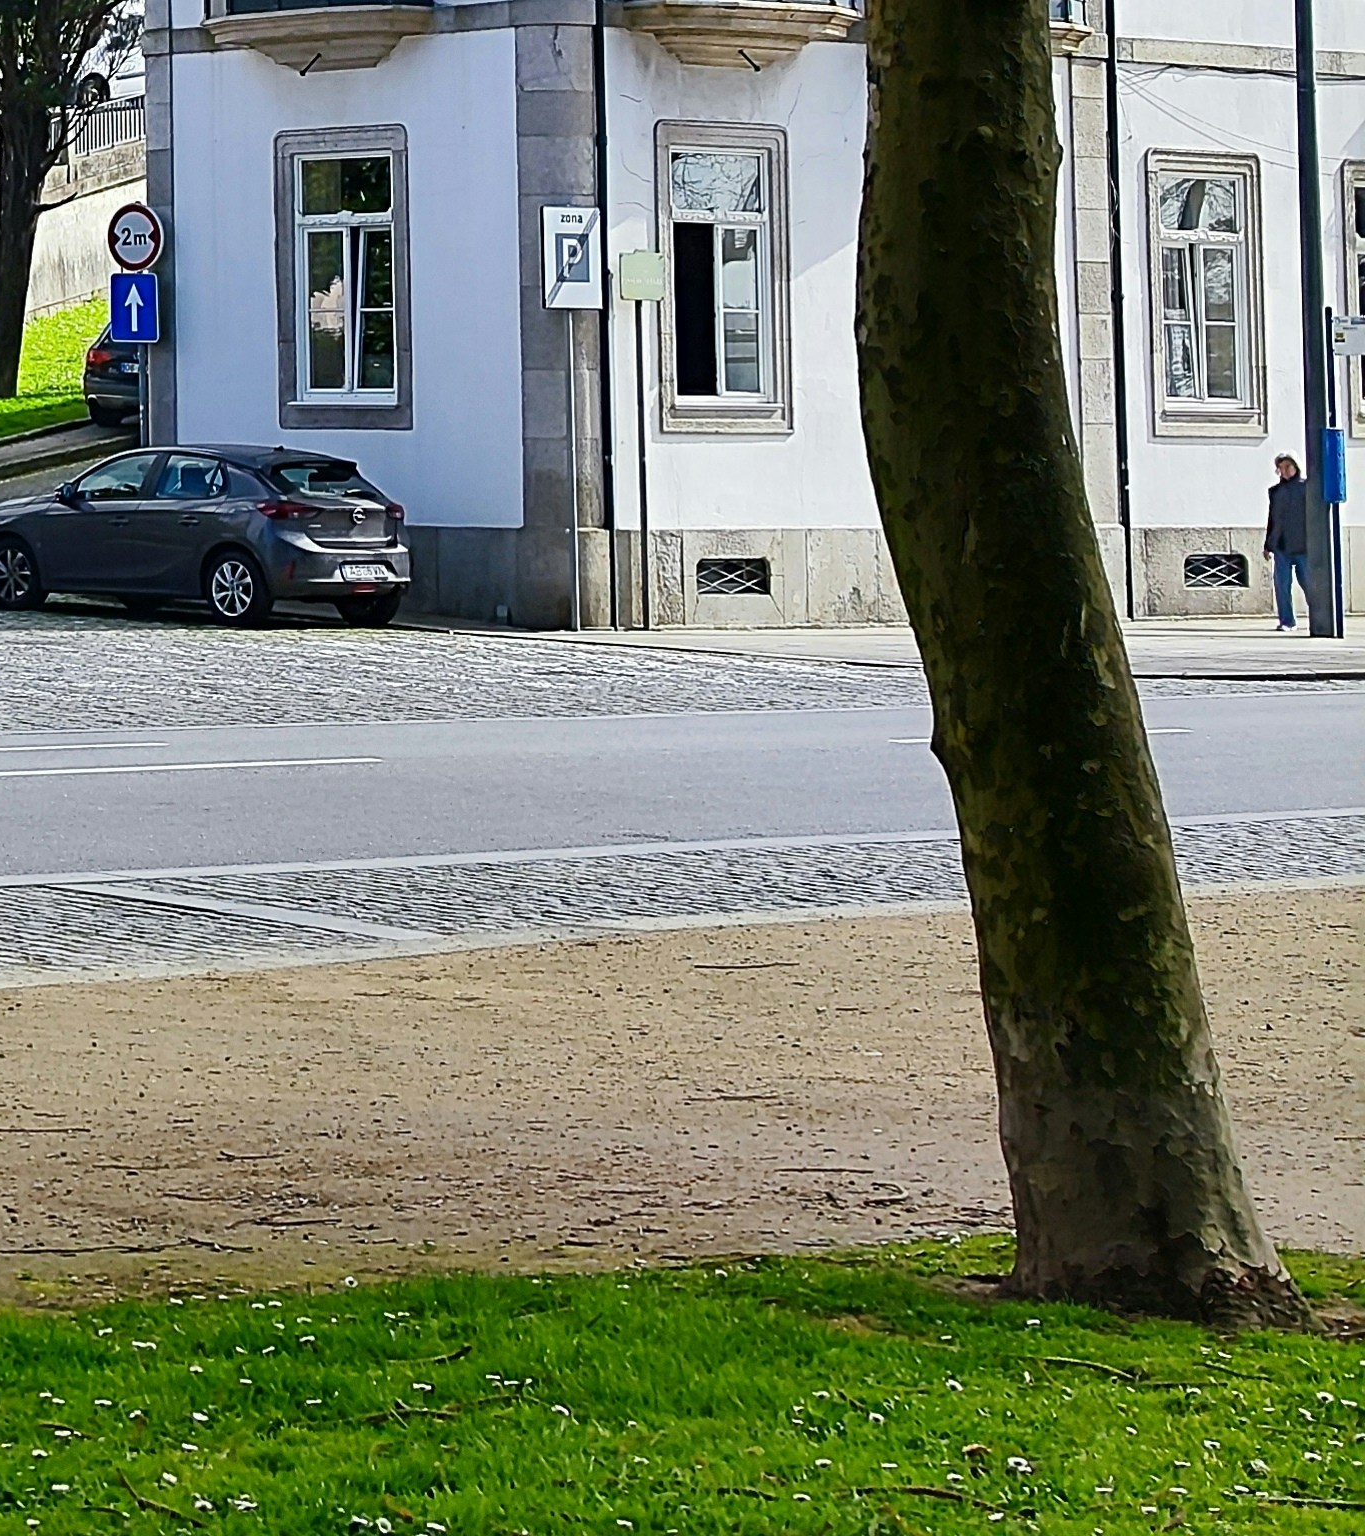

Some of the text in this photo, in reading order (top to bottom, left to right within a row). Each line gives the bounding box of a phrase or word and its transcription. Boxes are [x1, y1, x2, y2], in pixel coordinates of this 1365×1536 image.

[560, 213, 584, 224] zona
[120, 227, 148, 246] 2m
[562, 238, 583, 277] P
